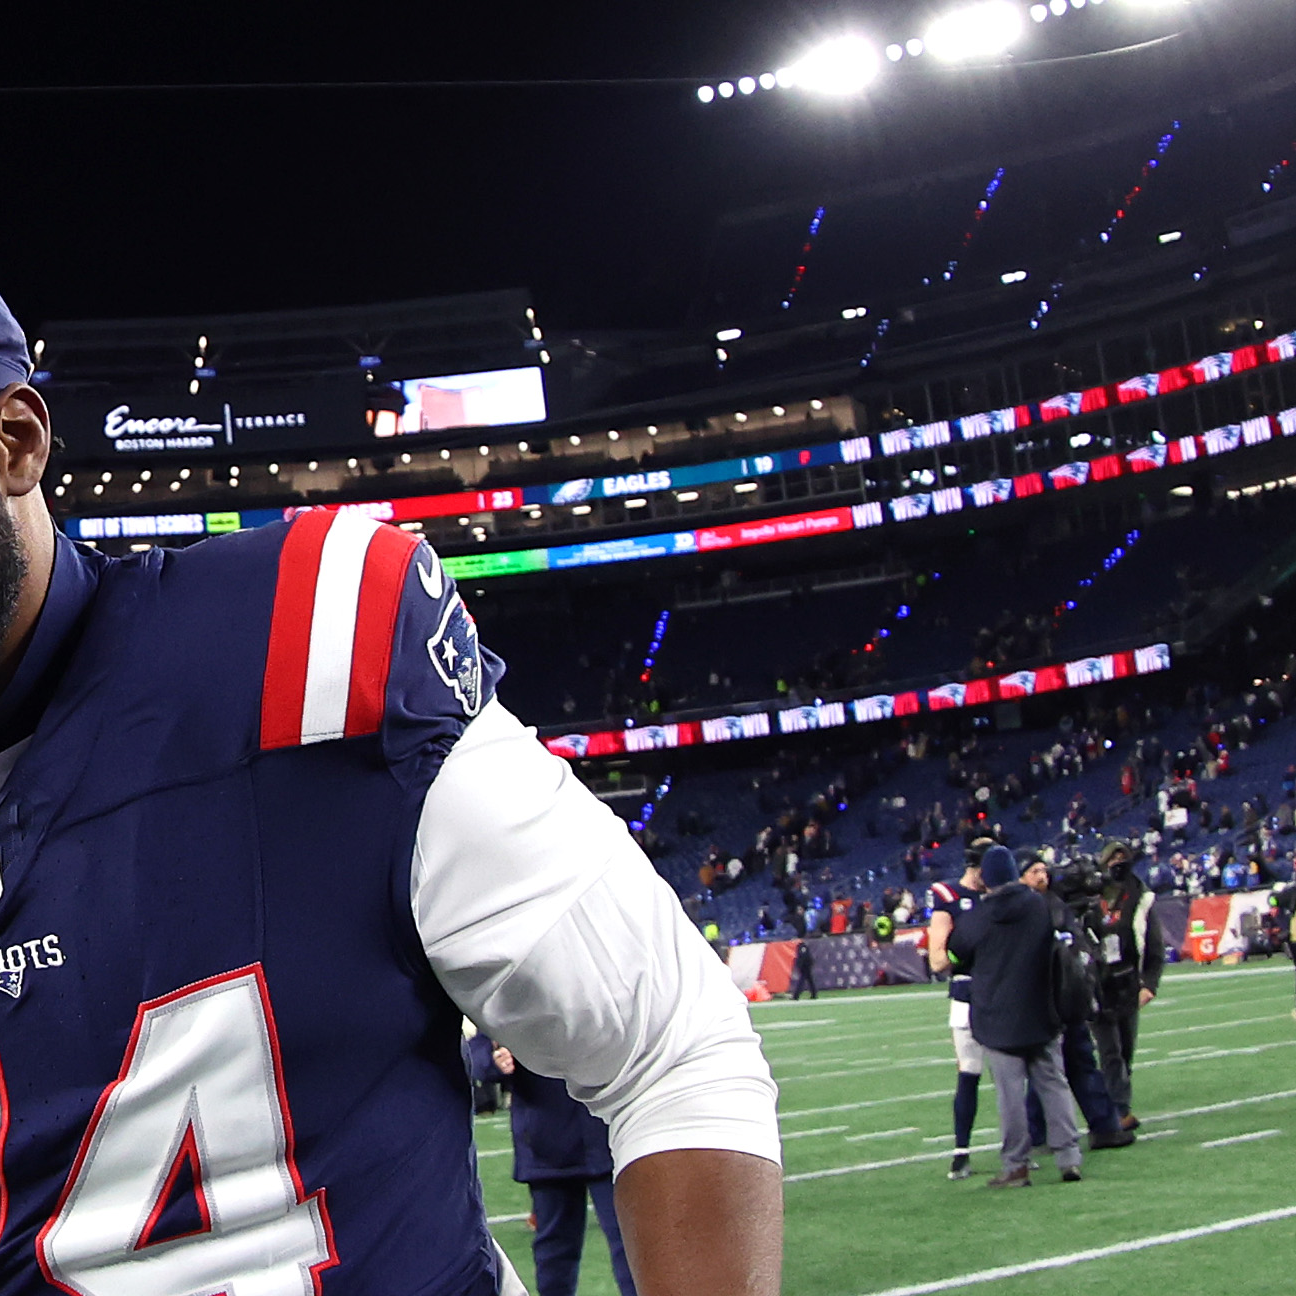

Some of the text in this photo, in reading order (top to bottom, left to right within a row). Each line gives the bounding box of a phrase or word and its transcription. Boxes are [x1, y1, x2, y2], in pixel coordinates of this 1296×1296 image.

[105, 404, 223, 438] Encore
[235, 413, 307, 429] TERRACE
[923, 421, 951, 447] WIN
[1242, 416, 1272, 446] WIN
[115, 436, 215, 451] BOSTON HARBOR
[840, 437, 872, 464] WIN
[602, 455, 774, 497] EAGLES 19
[932, 487, 963, 515] WIN
[157, 514, 205, 537] SCORES
[852, 502, 883, 529] WIN
[742, 712, 770, 738] WIN
[818, 702, 846, 728] WIN
